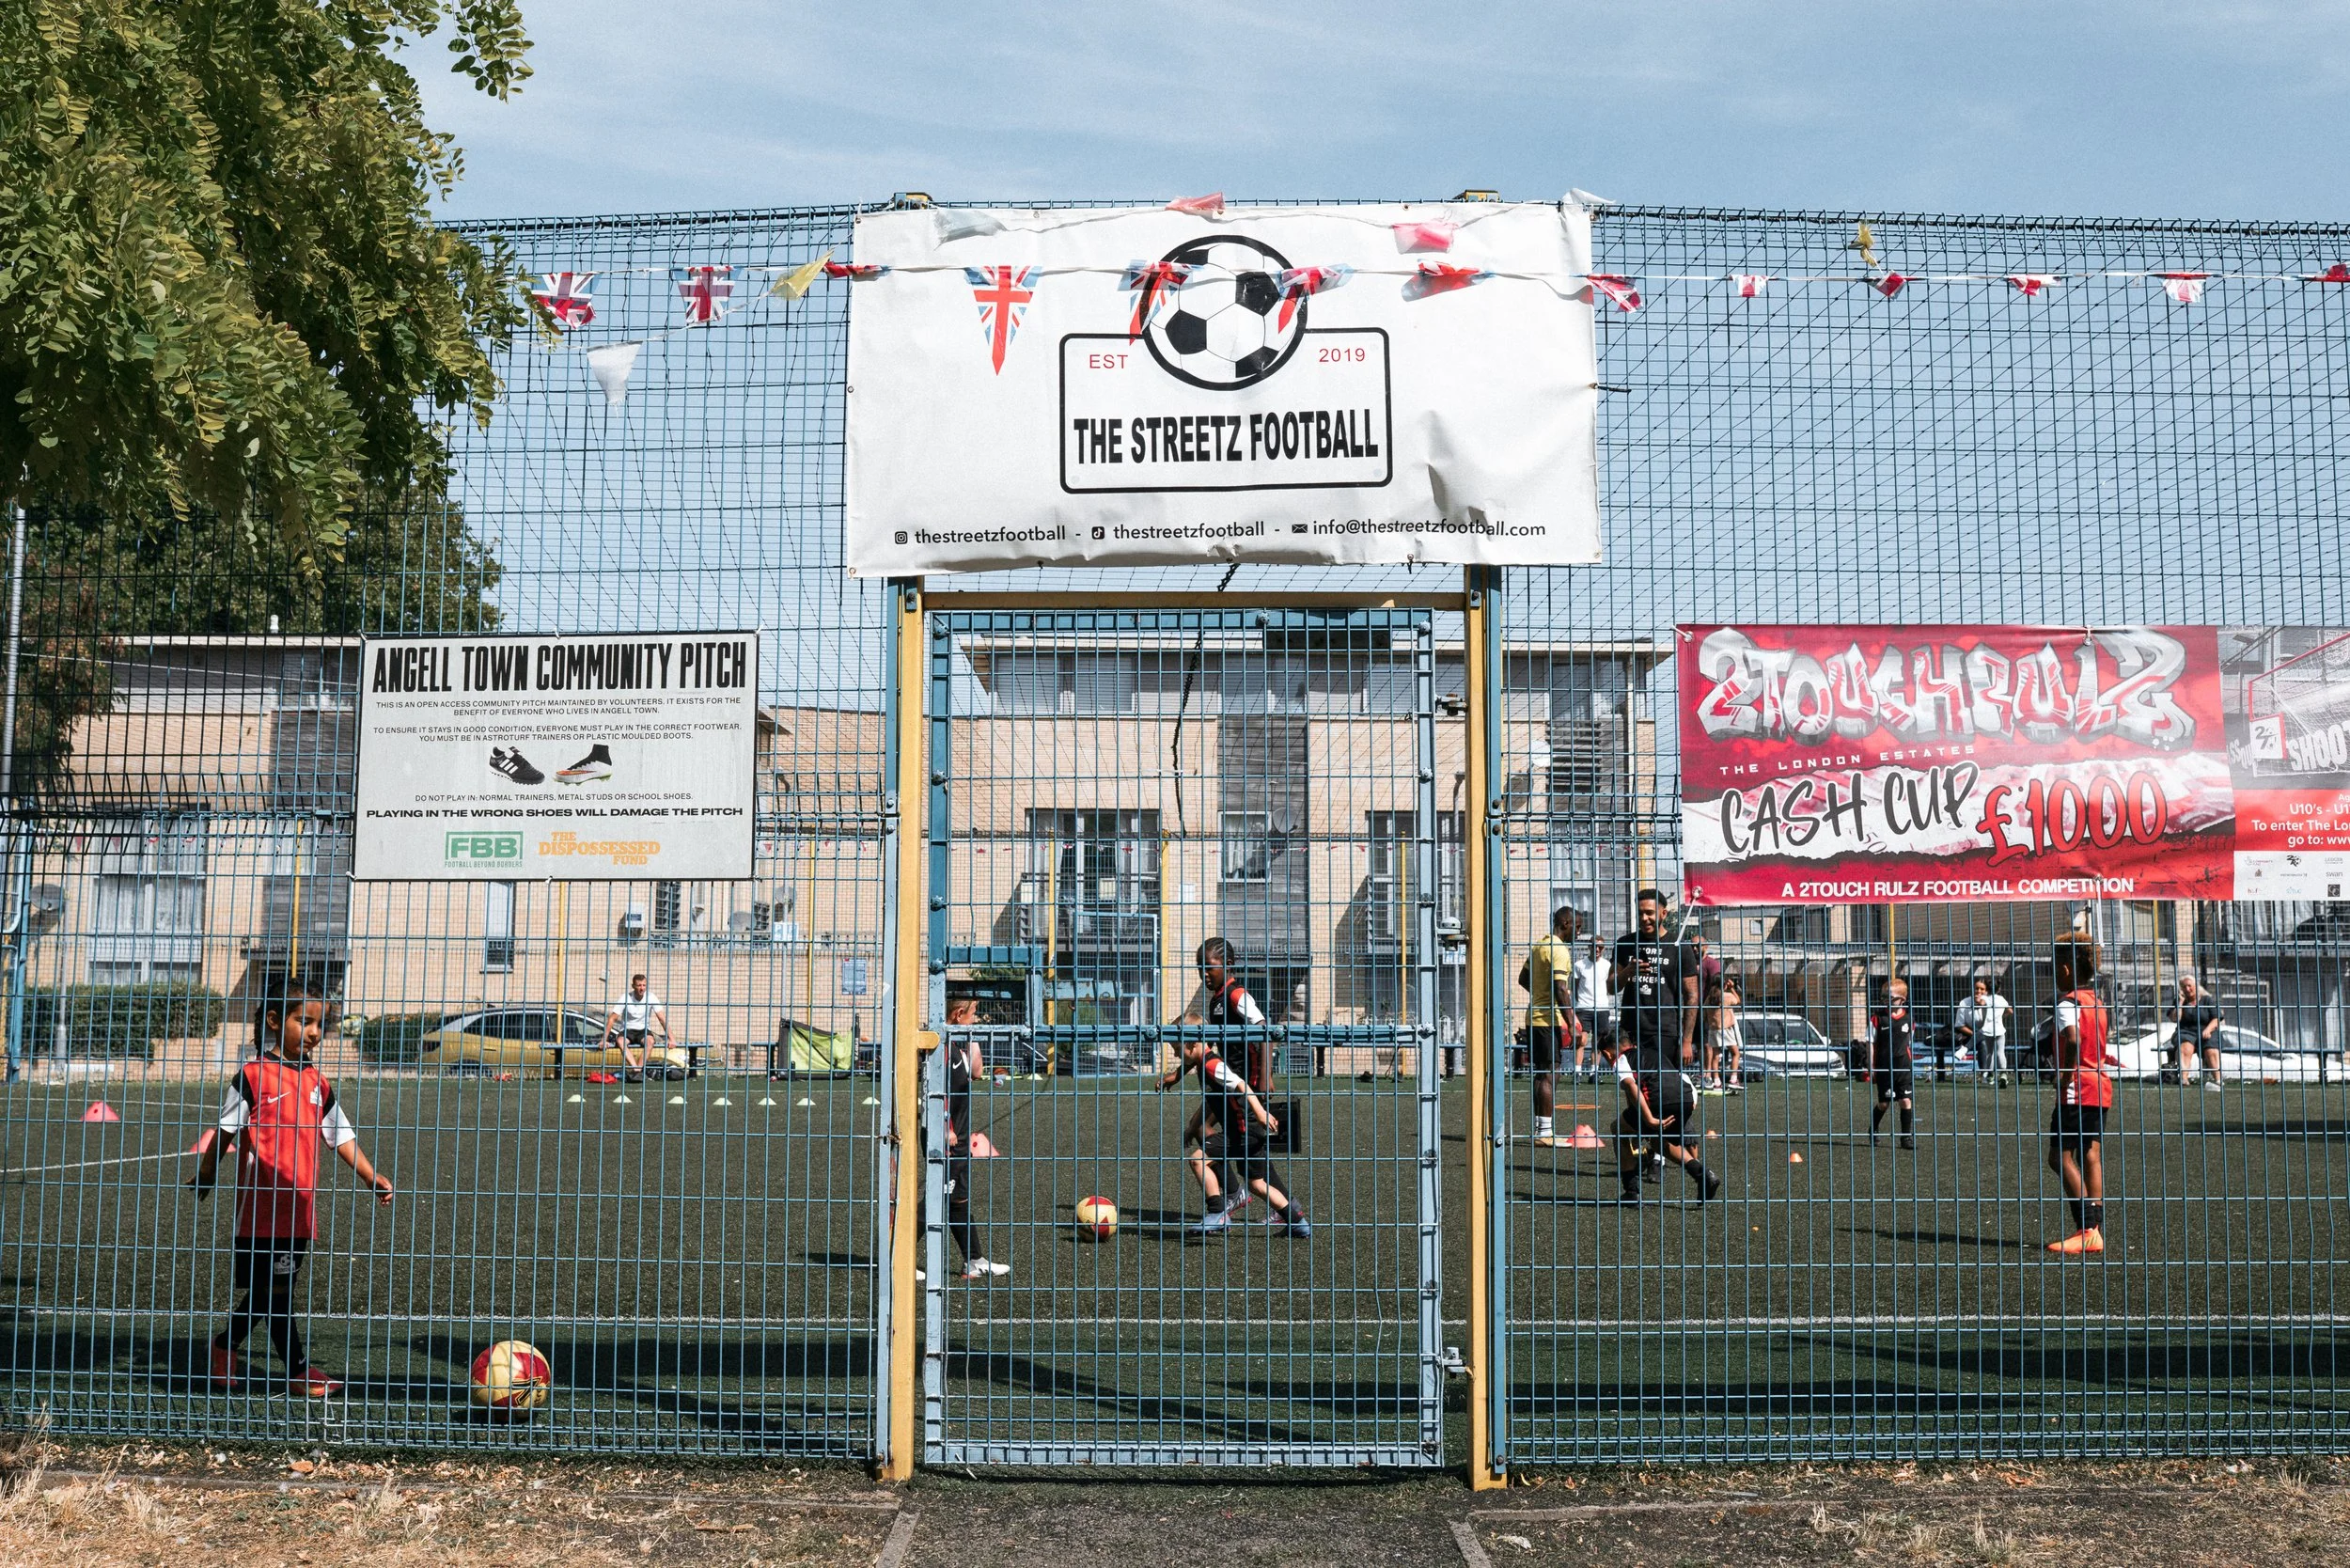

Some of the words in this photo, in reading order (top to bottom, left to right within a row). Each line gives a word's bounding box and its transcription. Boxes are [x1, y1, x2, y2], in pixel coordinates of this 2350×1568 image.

[1089, 354, 1128, 368] EST
[1318, 348, 1366, 362] 2019
[1073, 419, 1123, 464] THE
[1131, 415, 1242, 463] STREETZ
[1249, 409, 1379, 459] FOOTBALL
[914, 525, 1065, 543] thestreetzfootball
[1113, 520, 1263, 540] thestreetzfootball
[1313, 518, 1544, 536] info@thestreetzfootball.com
[372, 647, 452, 693] ANGELL
[462, 645, 529, 691] TOWN
[536, 643, 673, 690] COMMUNITY
[680, 641, 746, 688] PITCH
[472, 699, 521, 708] COMMUNITY
[547, 698, 596, 707] MAINTAINED
[609, 698, 666, 706] VOLUNTEERS.
[676, 697, 705, 705] EXISTS
[453, 708, 488, 716] BENEFIT
[462, 725, 486, 733] GOOD
[1719, 763, 1759, 776] THE
[1778, 754, 1861, 770] LONDON
[1880, 745, 1975, 761] ESTATES
[366, 809, 423, 818] PLAYING
[470, 808, 524, 817] WRONG
[525, 808, 572, 817] SHOES
[610, 808, 668, 816] DAMAGE
[671, 808, 698, 816] THE
[1721, 773, 1867, 853] CASH
[1884, 760, 1979, 835] CUP
[1975, 771, 2169, 867] £1000
[2290, 804, 2323, 815] U10's
[2334, 804, 2350, 815] U1
[2251, 820, 2267, 831] To
[2270, 821, 2304, 831] enter
[2306, 820, 2330, 831] The
[2334, 820, 2350, 831] Lo
[551, 831, 576, 842] THE
[2288, 836, 2305, 848] go
[2308, 834, 2324, 844] to:
[450, 837, 518, 858] FBB
[539, 841, 661, 855] DISPOSSESSED
[612, 855, 648, 865] FUND
[1781, 883, 1794, 897] A
[1799, 882, 1869, 897] 2TOUCH
[1874, 882, 1919, 896] RULZ
[1923, 880, 2015, 895] FOOTBALL
[2017, 878, 2134, 894] COMPETIION
